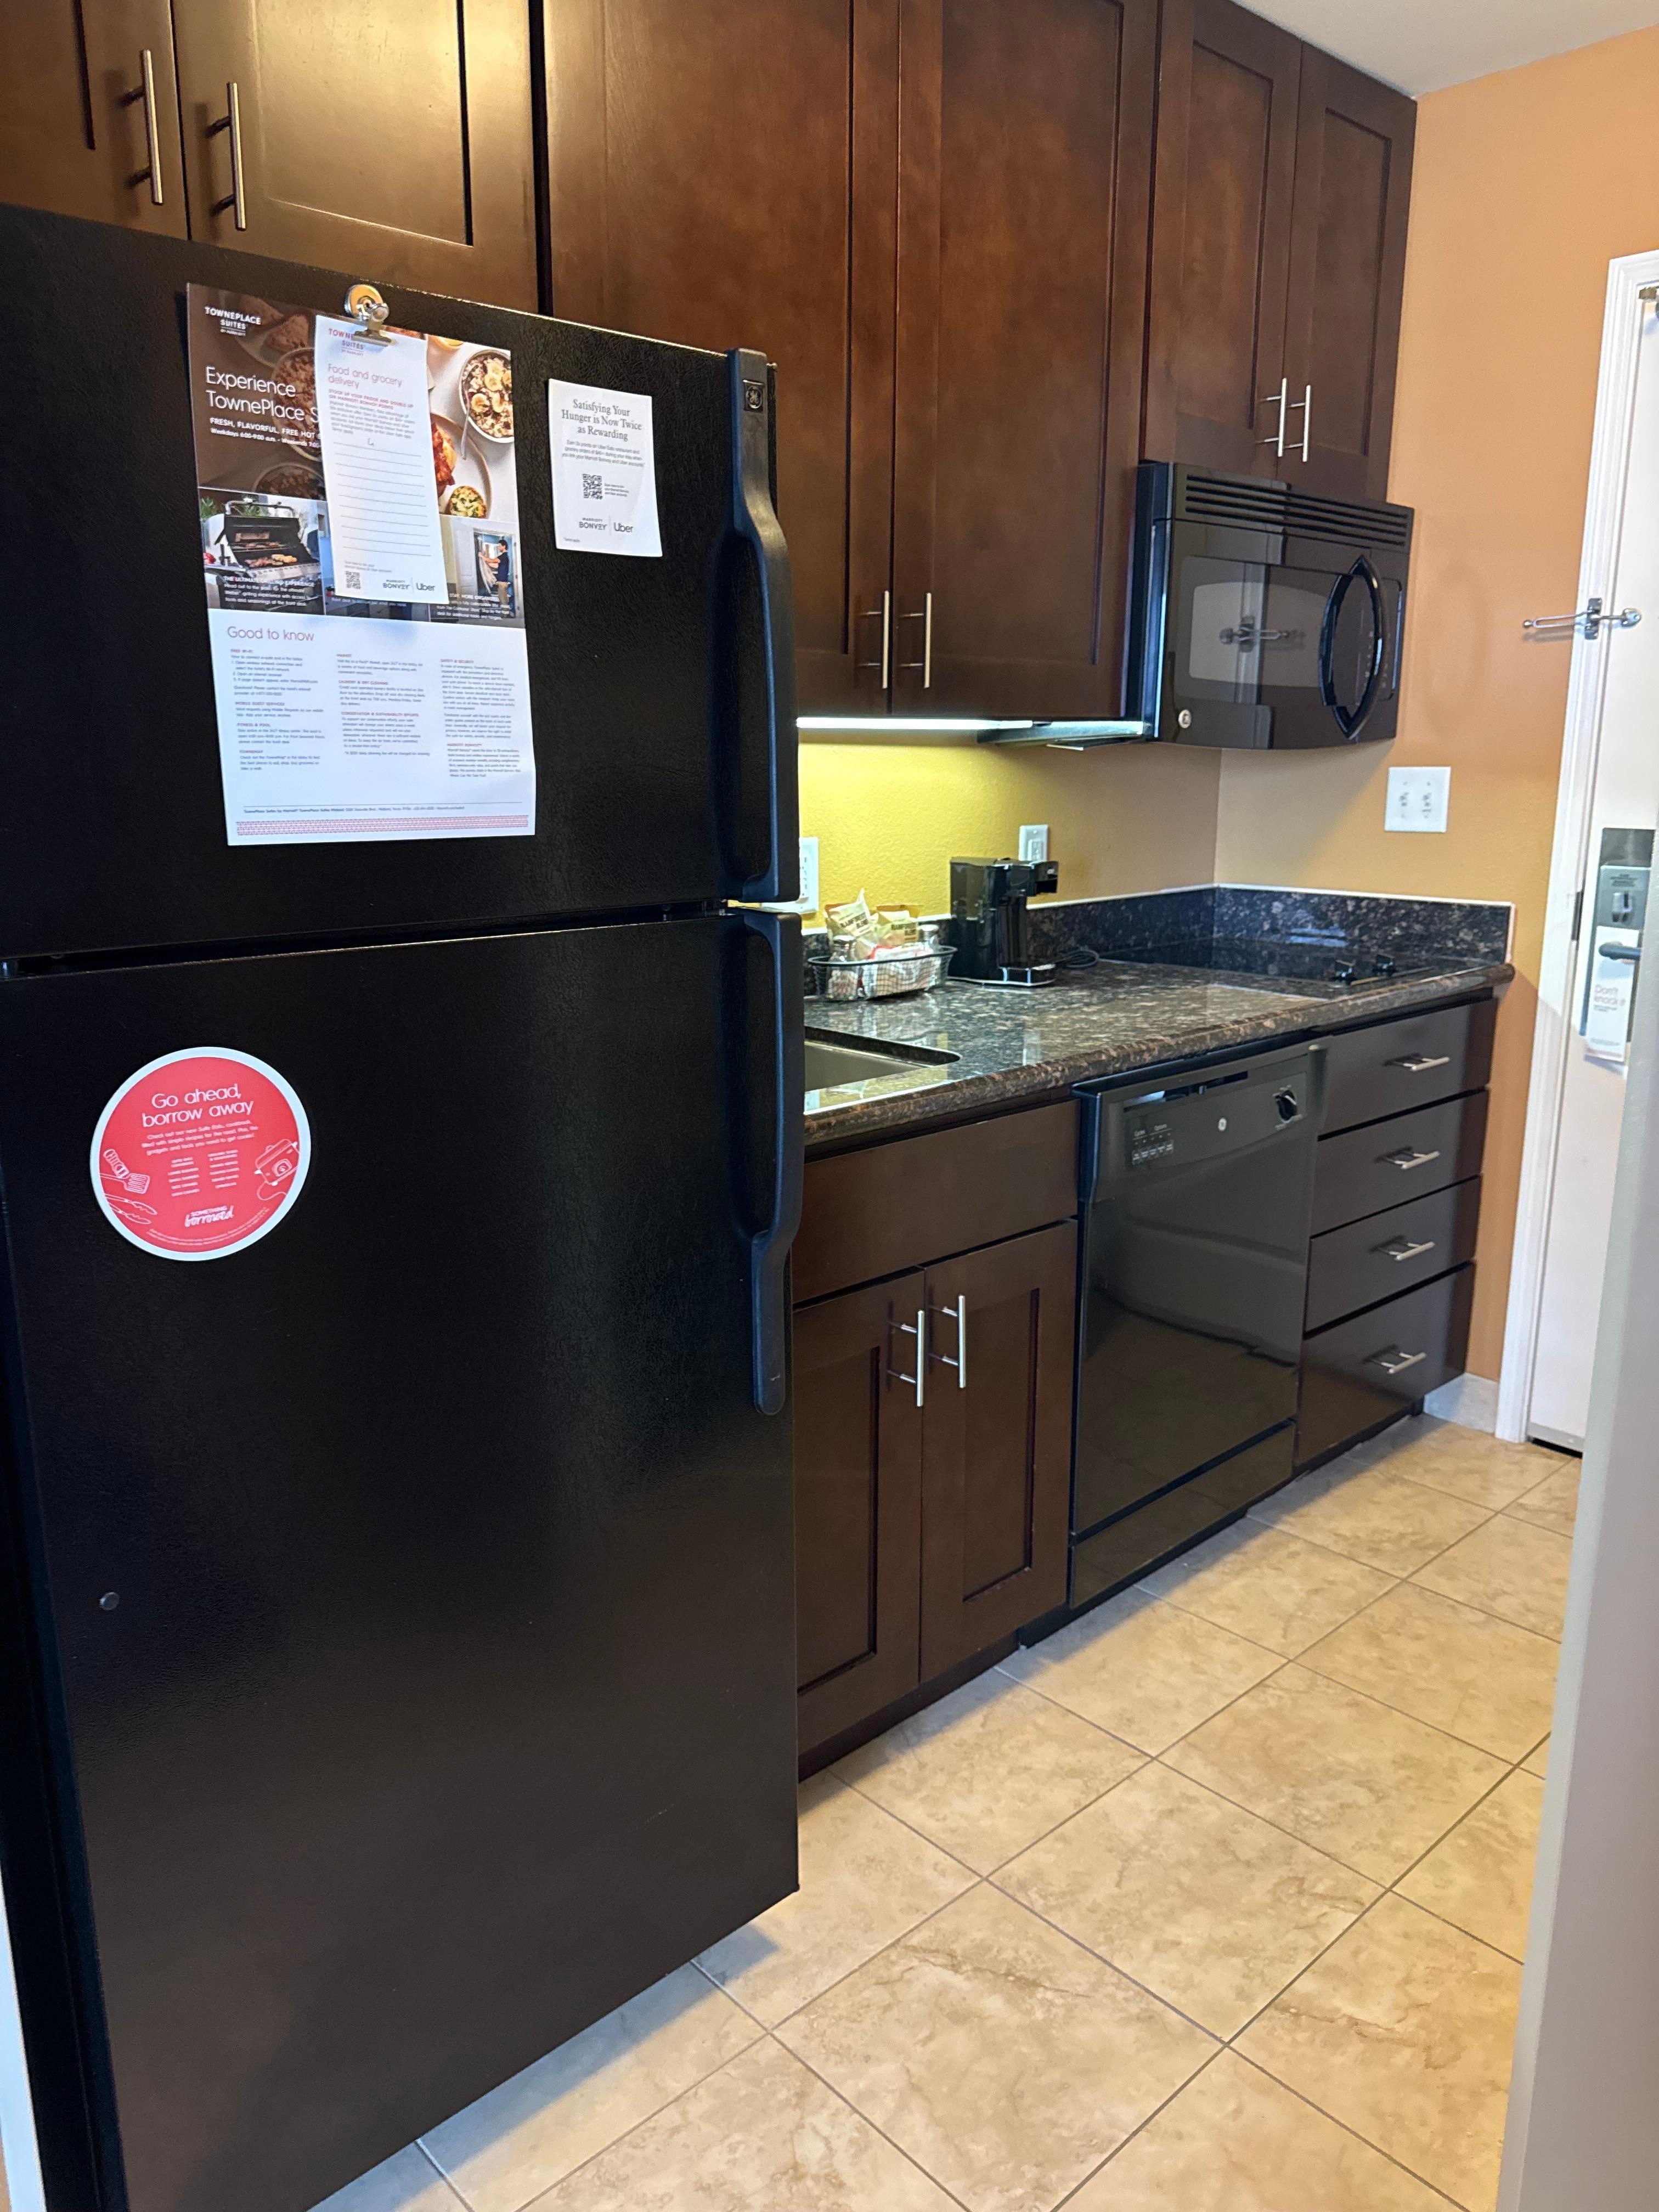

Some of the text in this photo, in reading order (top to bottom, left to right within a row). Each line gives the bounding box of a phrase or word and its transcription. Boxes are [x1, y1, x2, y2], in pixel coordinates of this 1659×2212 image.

[204, 306, 262, 325] TOWNEPLACE
[220, 319, 246, 330] SUITES
[342, 340, 364, 350] SUITES
[206, 366, 296, 397] Experience
[328, 363, 403, 387] Food and grocery
[329, 375, 360, 390] delivery
[206, 390, 305, 421] TownePlace
[573, 399, 630, 417] Satisfying Your
[561, 409, 642, 431] Hunger is Now Twice
[282, 428, 299, 437] FREE
[578, 425, 629, 442] as Rewarding
[579, 521, 634, 533] BONVOY Uber
[416, 582, 435, 591] Uber
[227, 626, 315, 641] Good to know
[151, 1083, 242, 1109] Go ahead,
[142, 1108, 204, 1127] borrow
[208, 1100, 255, 1118] away
